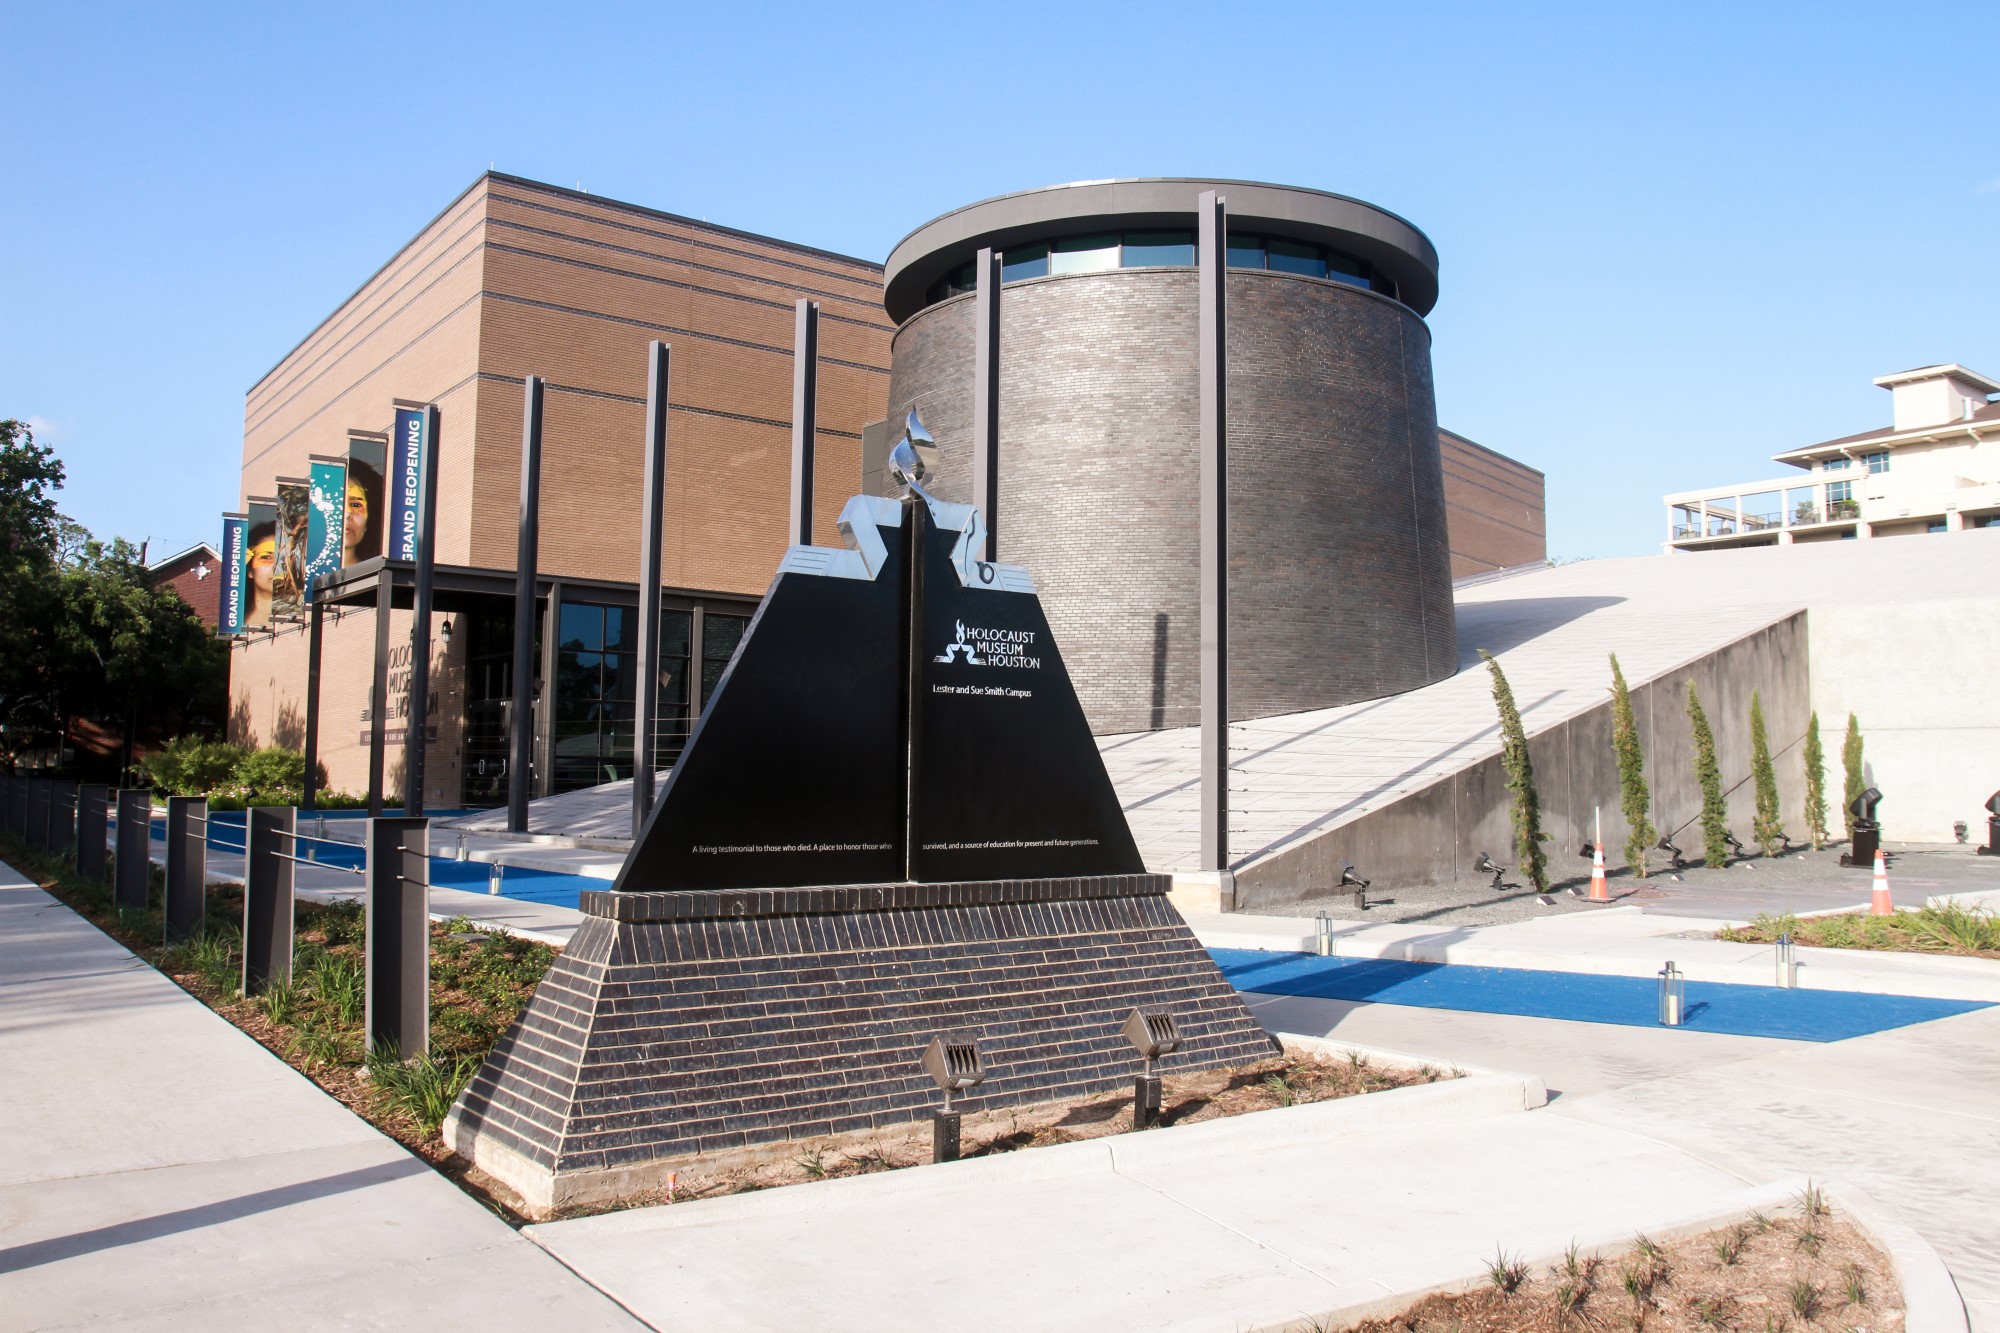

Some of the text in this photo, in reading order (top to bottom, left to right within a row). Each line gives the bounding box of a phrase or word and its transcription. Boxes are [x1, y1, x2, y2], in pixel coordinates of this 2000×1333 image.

[402, 420, 420, 561] GRAND REOPENING
[228, 526, 243, 628] GRAND REOPENING
[966, 627, 1035, 643] HOLOCAUST
[977, 641, 1023, 656] MUSEUM
[988, 654, 1040, 669] HOUSTON
[932, 683, 1032, 699] Lester and Sue Smith Campus
[692, 845, 698, 853] A
[699, 845, 718, 855] living
[718, 844, 755, 853] testimonial
[763, 844, 782, 852] those
[782, 843, 797, 852] who
[797, 843, 813, 851] died.
[813, 843, 819, 851] A
[819, 843, 836, 852] place
[836, 843, 843, 851] to
[862, 842, 879, 850] those
[879, 842, 893, 850] who
[922, 842, 948, 850] survived,
[989, 840, 1016, 848] education
[1024, 840, 1044, 848] present
[1044, 839, 1054, 847] and
[1070, 838, 1099, 847] generations.
